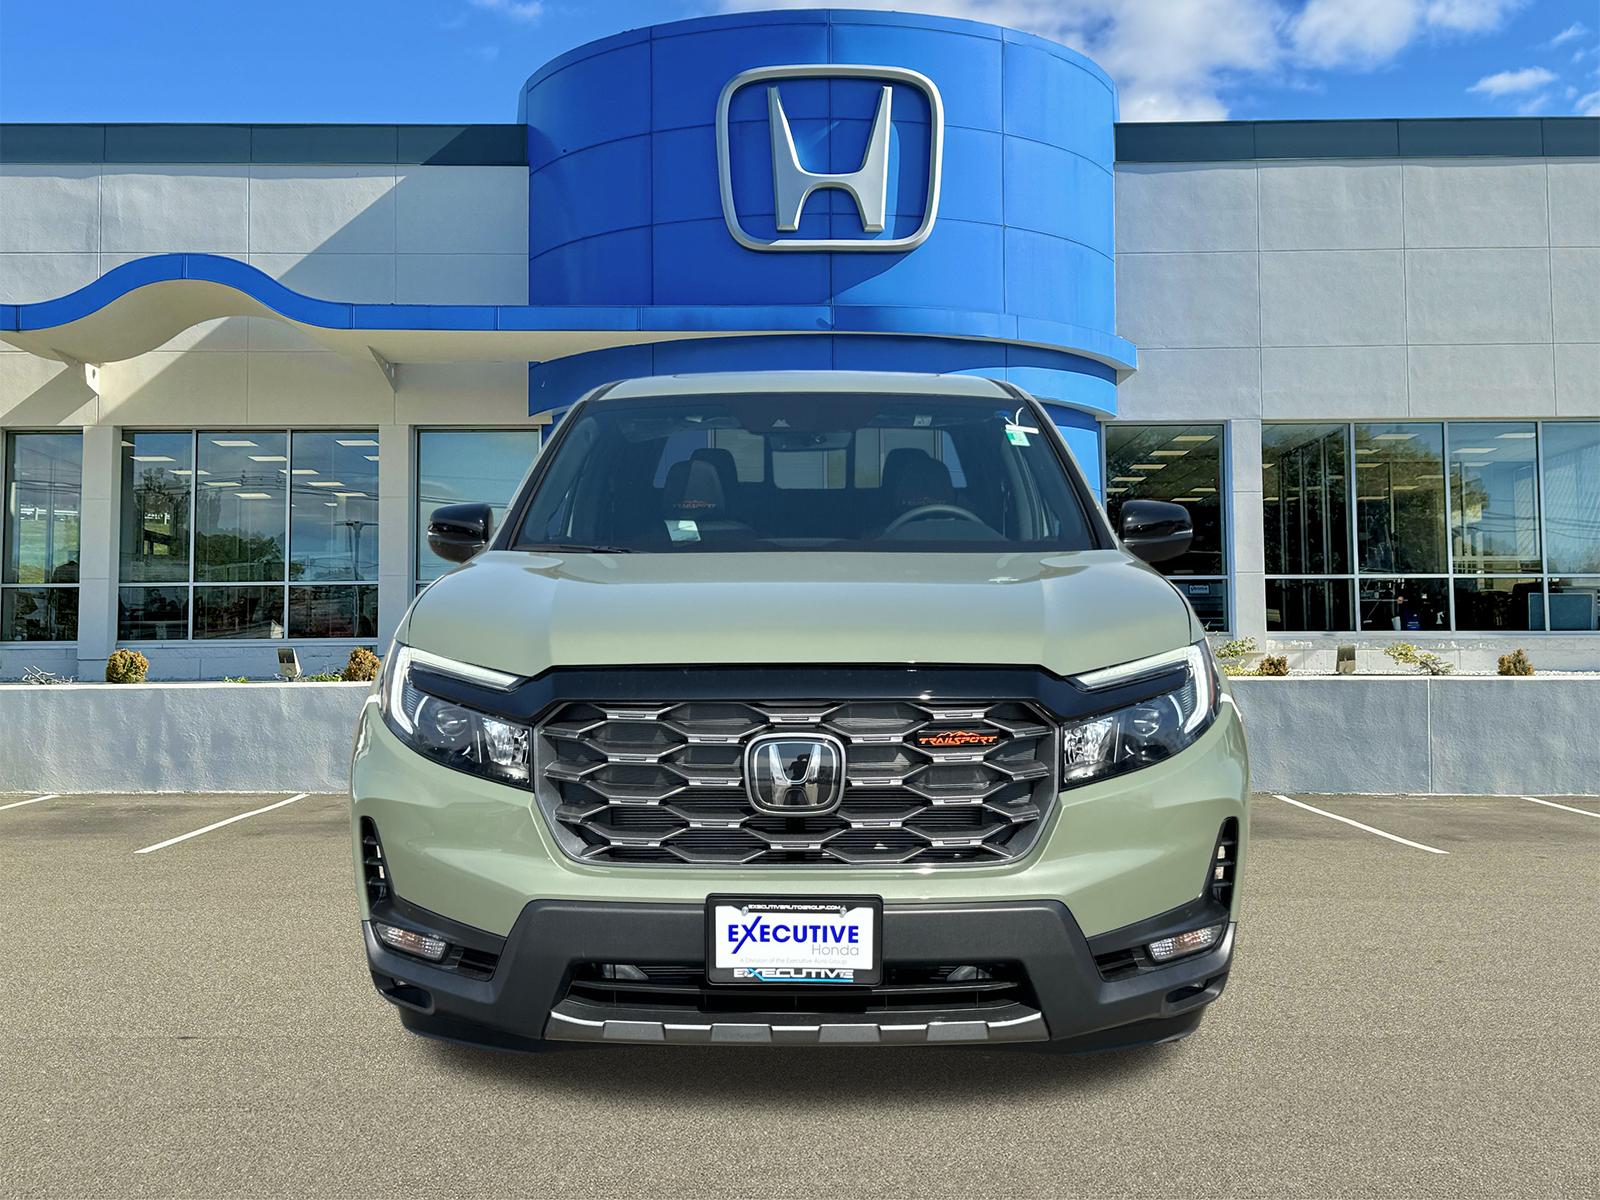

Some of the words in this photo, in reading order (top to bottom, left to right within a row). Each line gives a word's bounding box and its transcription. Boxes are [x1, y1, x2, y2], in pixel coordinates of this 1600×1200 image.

[919, 736, 997, 745] TRAILSPORT
[728, 916, 859, 954] EXECUTIVE
[811, 944, 859, 956] Honda
[734, 968, 854, 979] EXECUTIVE
